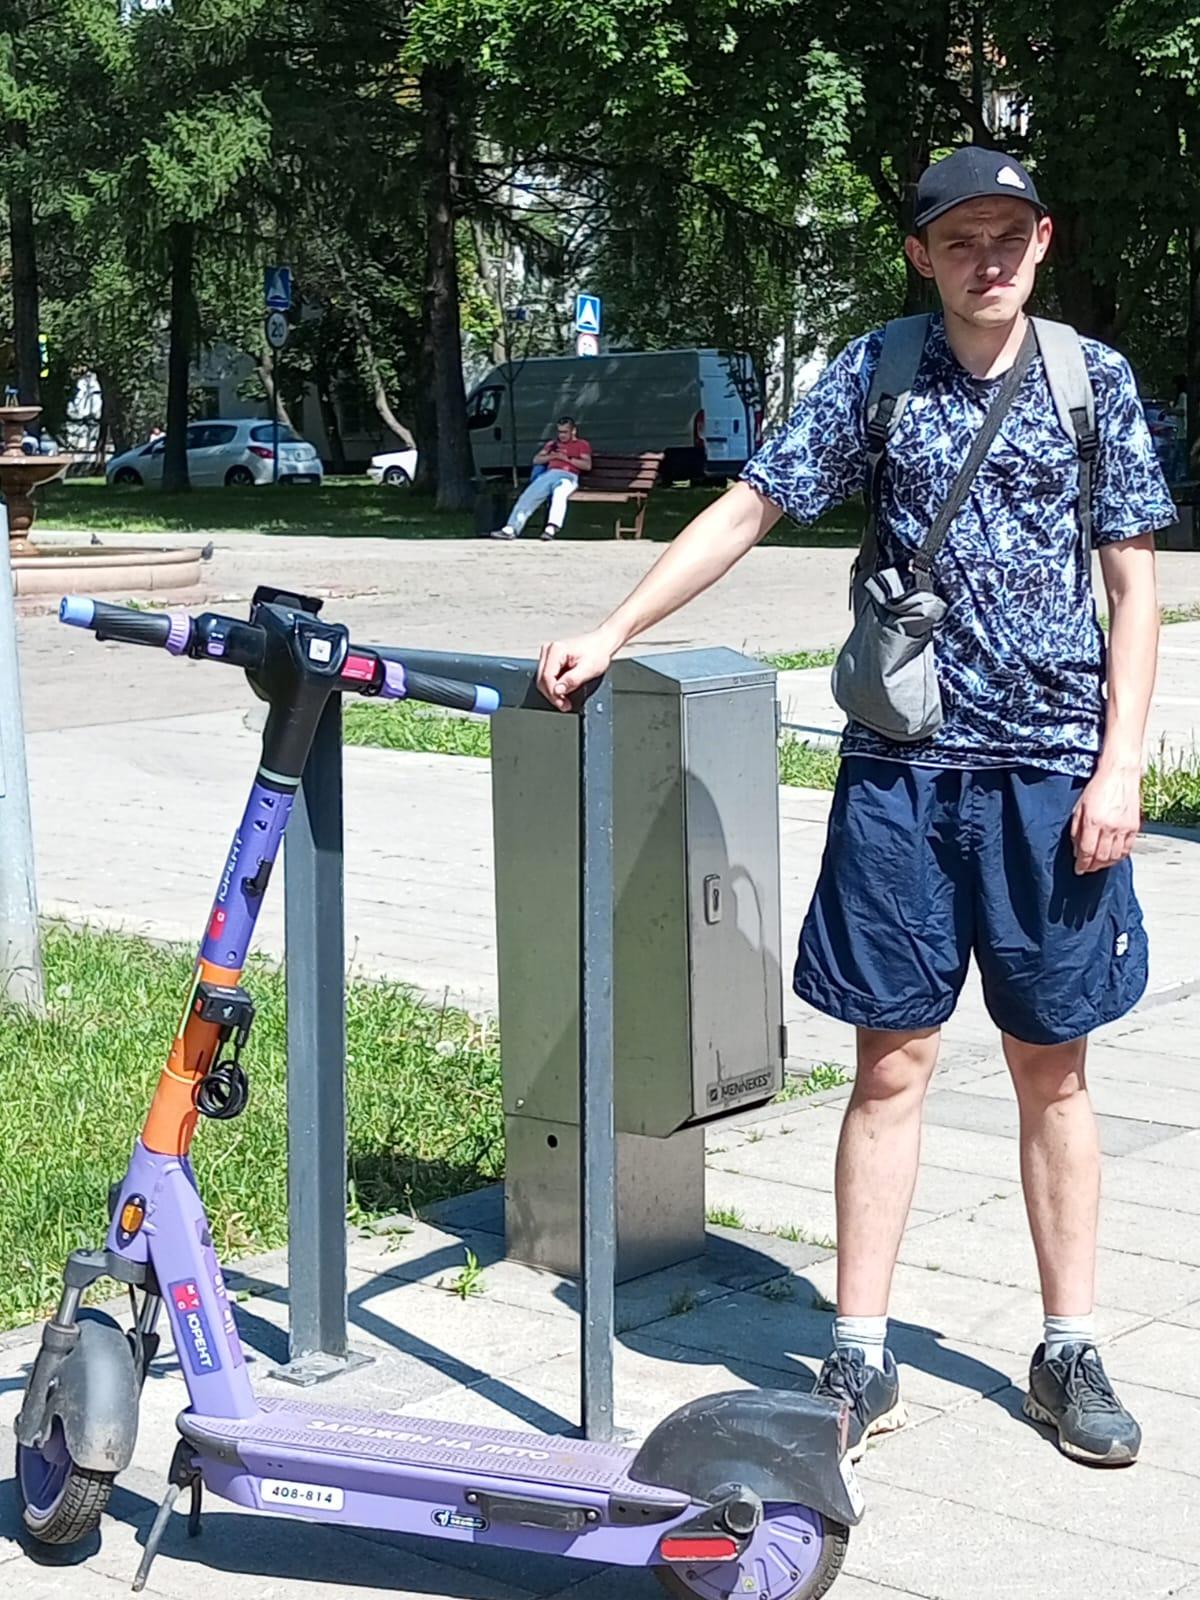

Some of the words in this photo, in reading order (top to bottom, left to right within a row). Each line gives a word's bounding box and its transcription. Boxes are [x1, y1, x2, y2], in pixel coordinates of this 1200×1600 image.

[186, 1312, 213, 1368] ЮРЕНТ
[306, 1420, 433, 1445] ЗАРЯЖЕН
[435, 1437, 473, 1451] НА
[271, 1486, 333, 1503] 408-814
